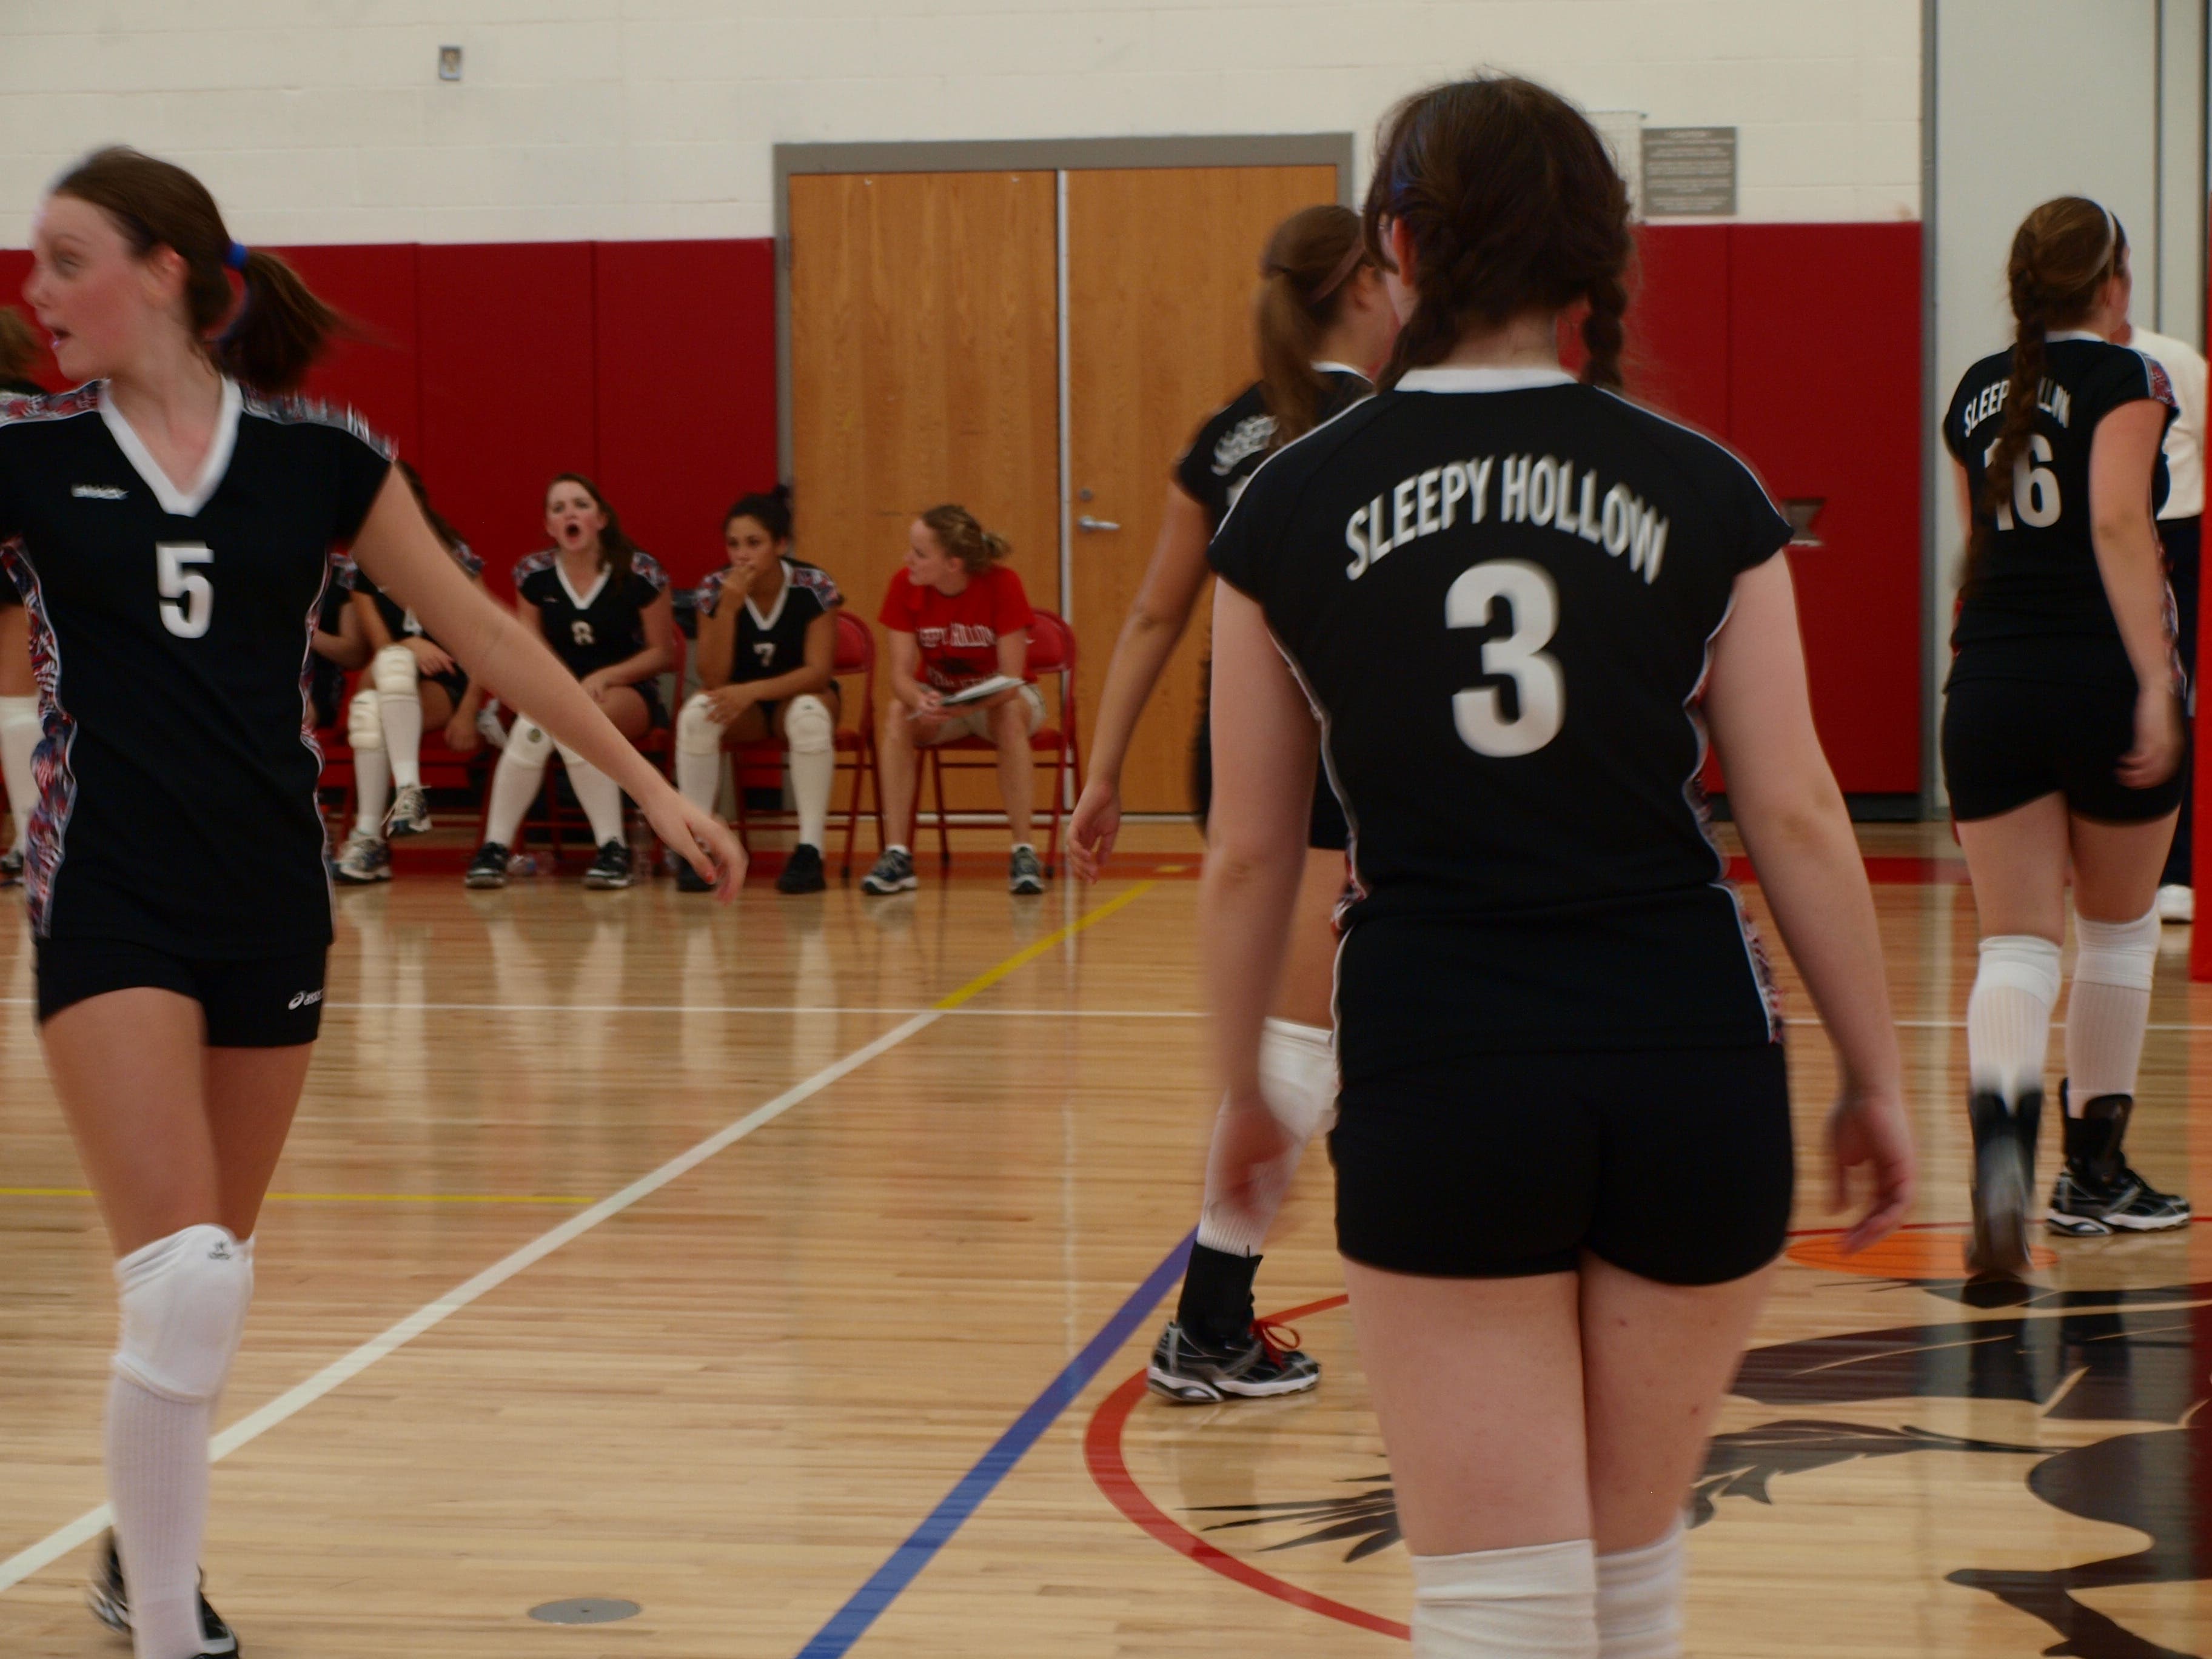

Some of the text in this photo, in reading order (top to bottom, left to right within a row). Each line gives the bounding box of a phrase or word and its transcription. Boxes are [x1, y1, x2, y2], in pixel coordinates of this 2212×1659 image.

[1964, 379, 2011, 438] SLEEP
[1346, 453, 1670, 585] SLEEPY HOLLOW
[155, 540, 215, 638] 5
[753, 642, 776, 667] 7
[1445, 557, 1566, 758] 3
